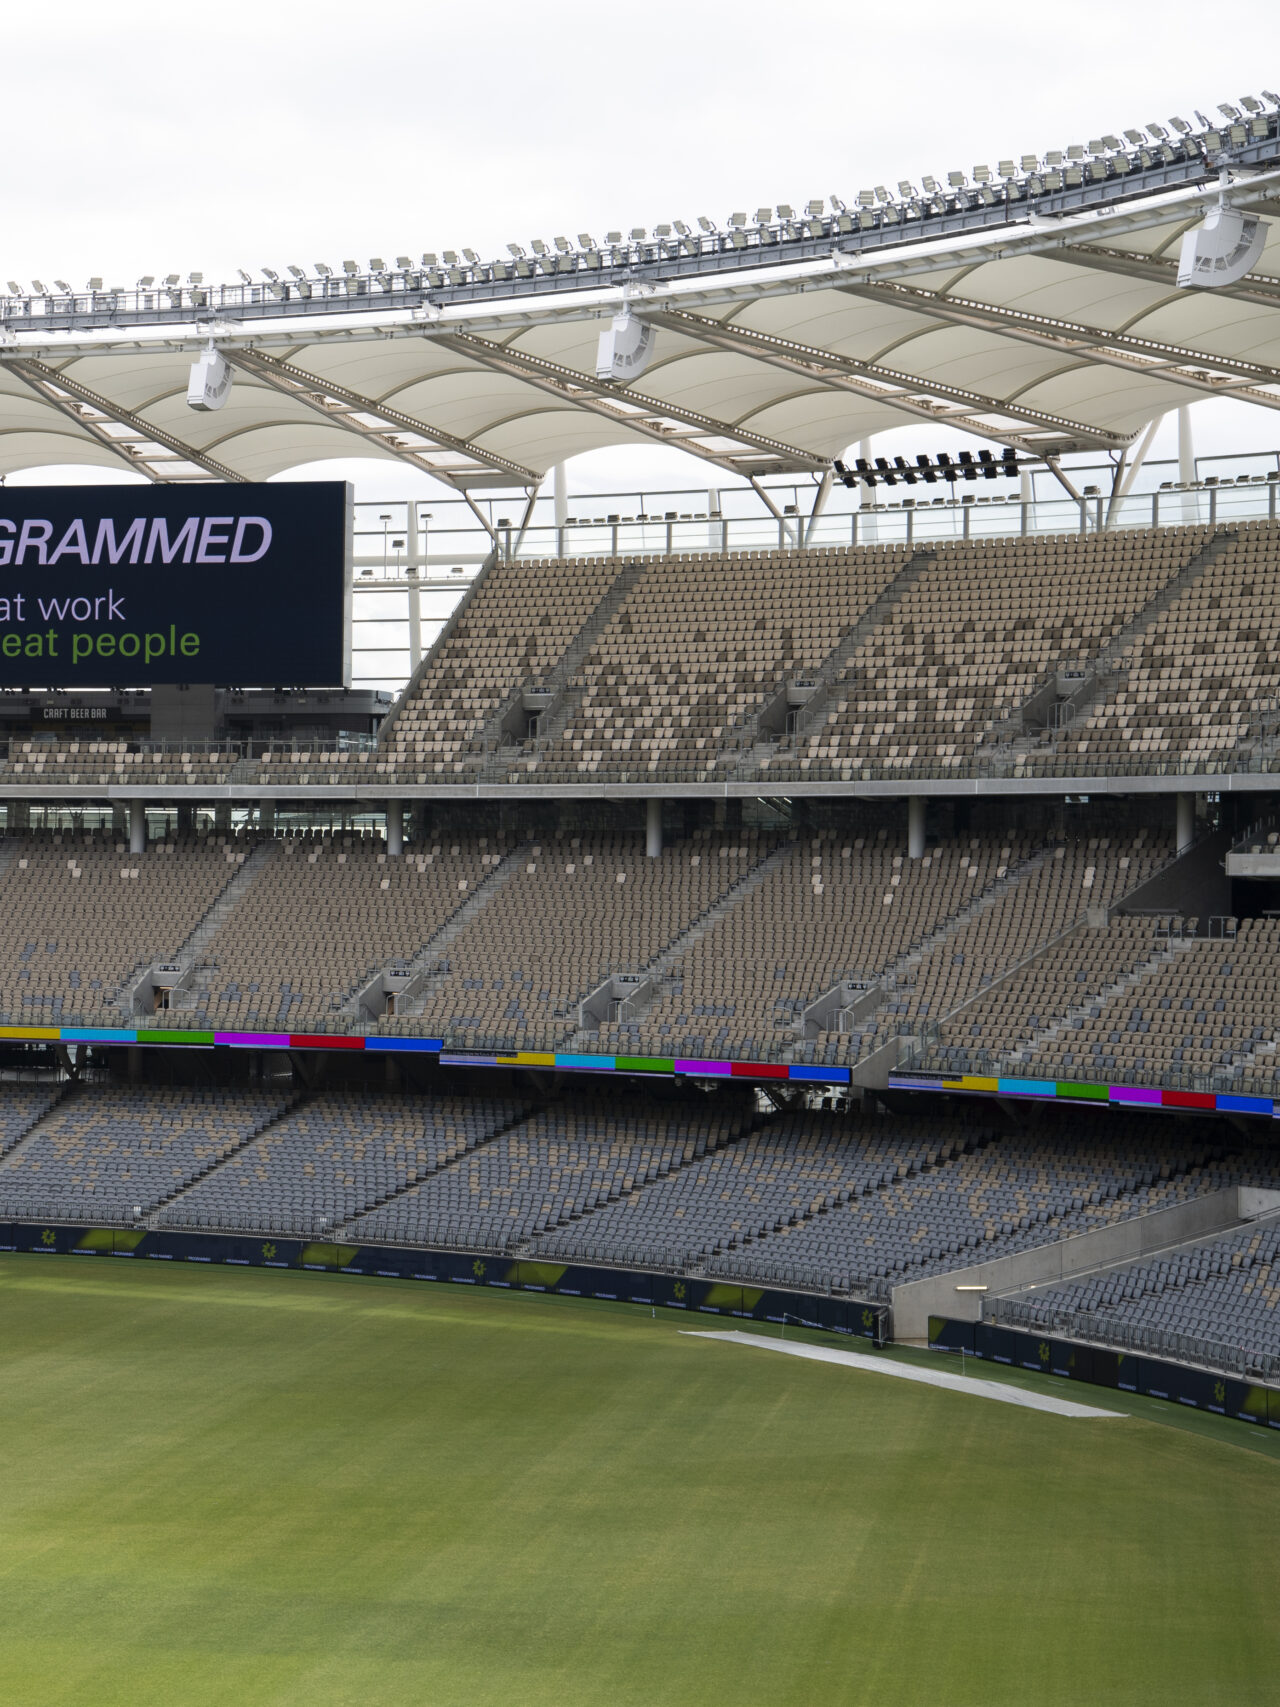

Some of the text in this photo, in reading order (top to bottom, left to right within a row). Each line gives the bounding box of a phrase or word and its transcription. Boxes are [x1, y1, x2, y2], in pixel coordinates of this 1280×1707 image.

[37, 588, 126, 622] work
[72, 624, 200, 664] people
[43, 708, 107, 719] CRAFT BEER BAR
